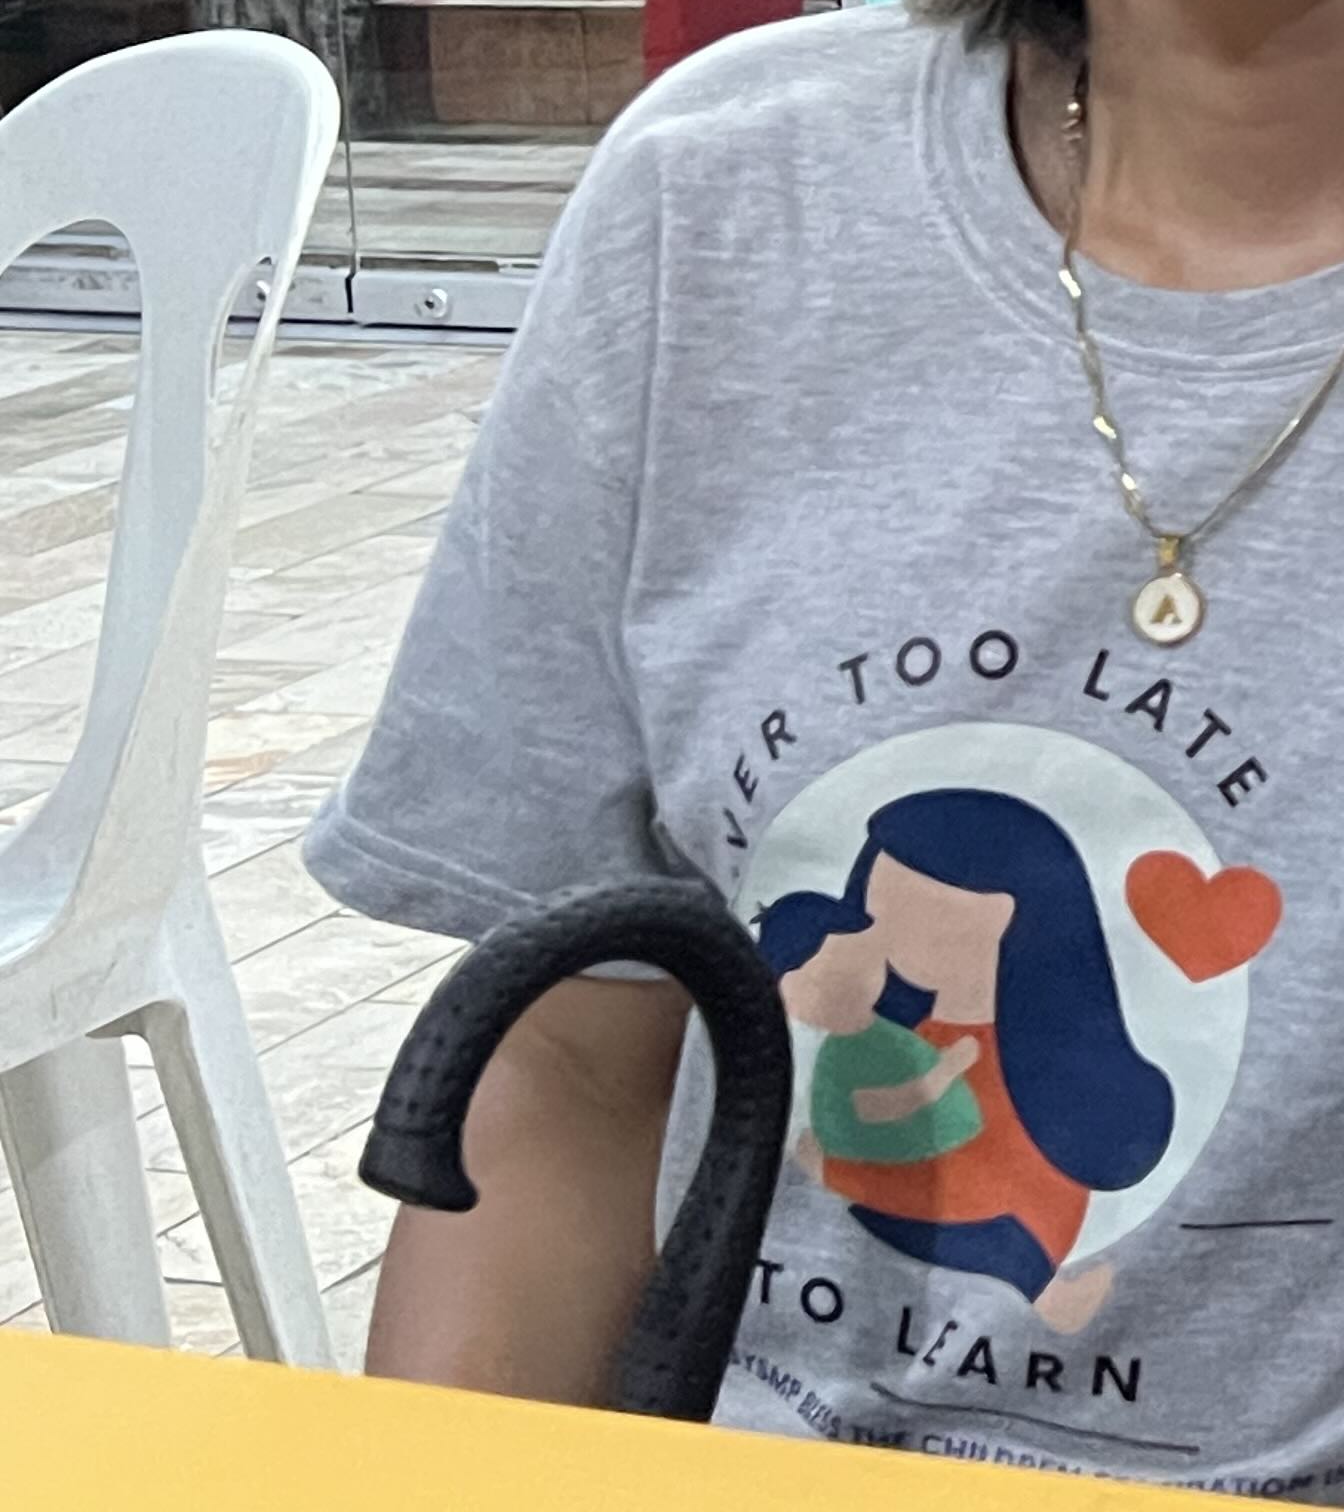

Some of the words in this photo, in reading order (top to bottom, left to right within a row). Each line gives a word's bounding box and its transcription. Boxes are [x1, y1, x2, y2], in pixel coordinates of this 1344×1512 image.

[723, 708, 798, 878] VER
[838, 629, 1018, 705] TOO
[1081, 648, 1269, 809] LATE
[750, 1258, 846, 1325] TO
[896, 1305, 1143, 1403] LEARN
